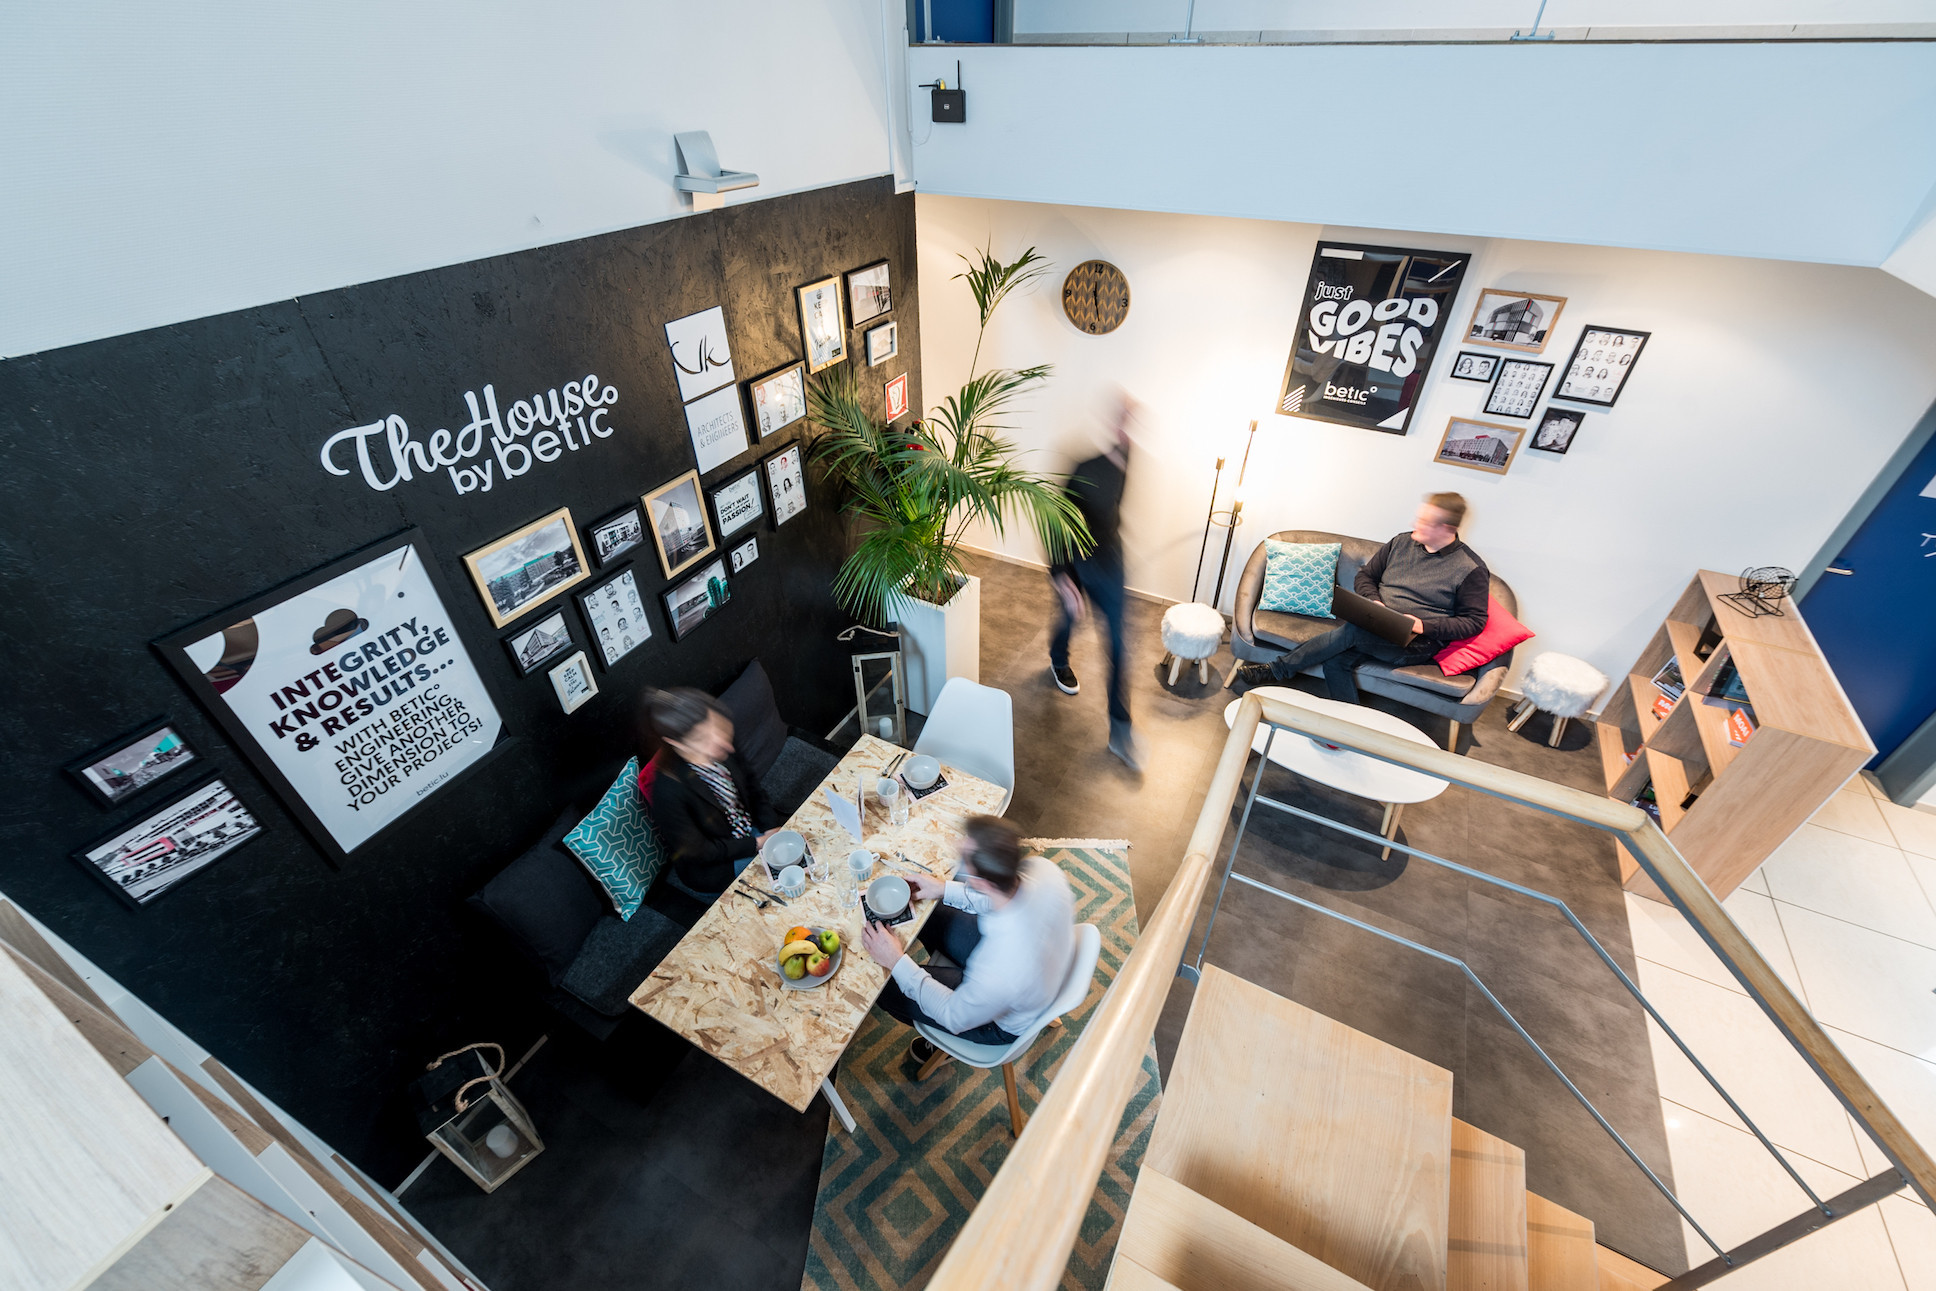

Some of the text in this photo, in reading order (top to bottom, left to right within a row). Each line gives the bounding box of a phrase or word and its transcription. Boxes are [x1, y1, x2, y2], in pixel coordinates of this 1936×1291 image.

[1310, 298, 1439, 336] GOOD
[1314, 281, 1354, 301] just
[1308, 323, 1424, 378] VIBES
[320, 374, 603, 491] The House
[697, 411, 734, 437] ARCHITECTS
[700, 421, 739, 449] & ENGINEERS
[448, 458, 493, 495] by
[736, 493, 749, 504] WAIT
[268, 627, 450, 740] KNOWLEDGE
[270, 616, 430, 711] INTEGRITY,
[295, 659, 454, 752] & RESULTS...
[334, 694, 458, 773] ENGINEERING,
[334, 718, 387, 754] WITH
[340, 700, 466, 786] GIVE ANOTHER
[347, 711, 471, 798] DIMENSION TO
[346, 717, 484, 812] YOUR PROJECTS!
[415, 771, 450, 797] betic.lu
